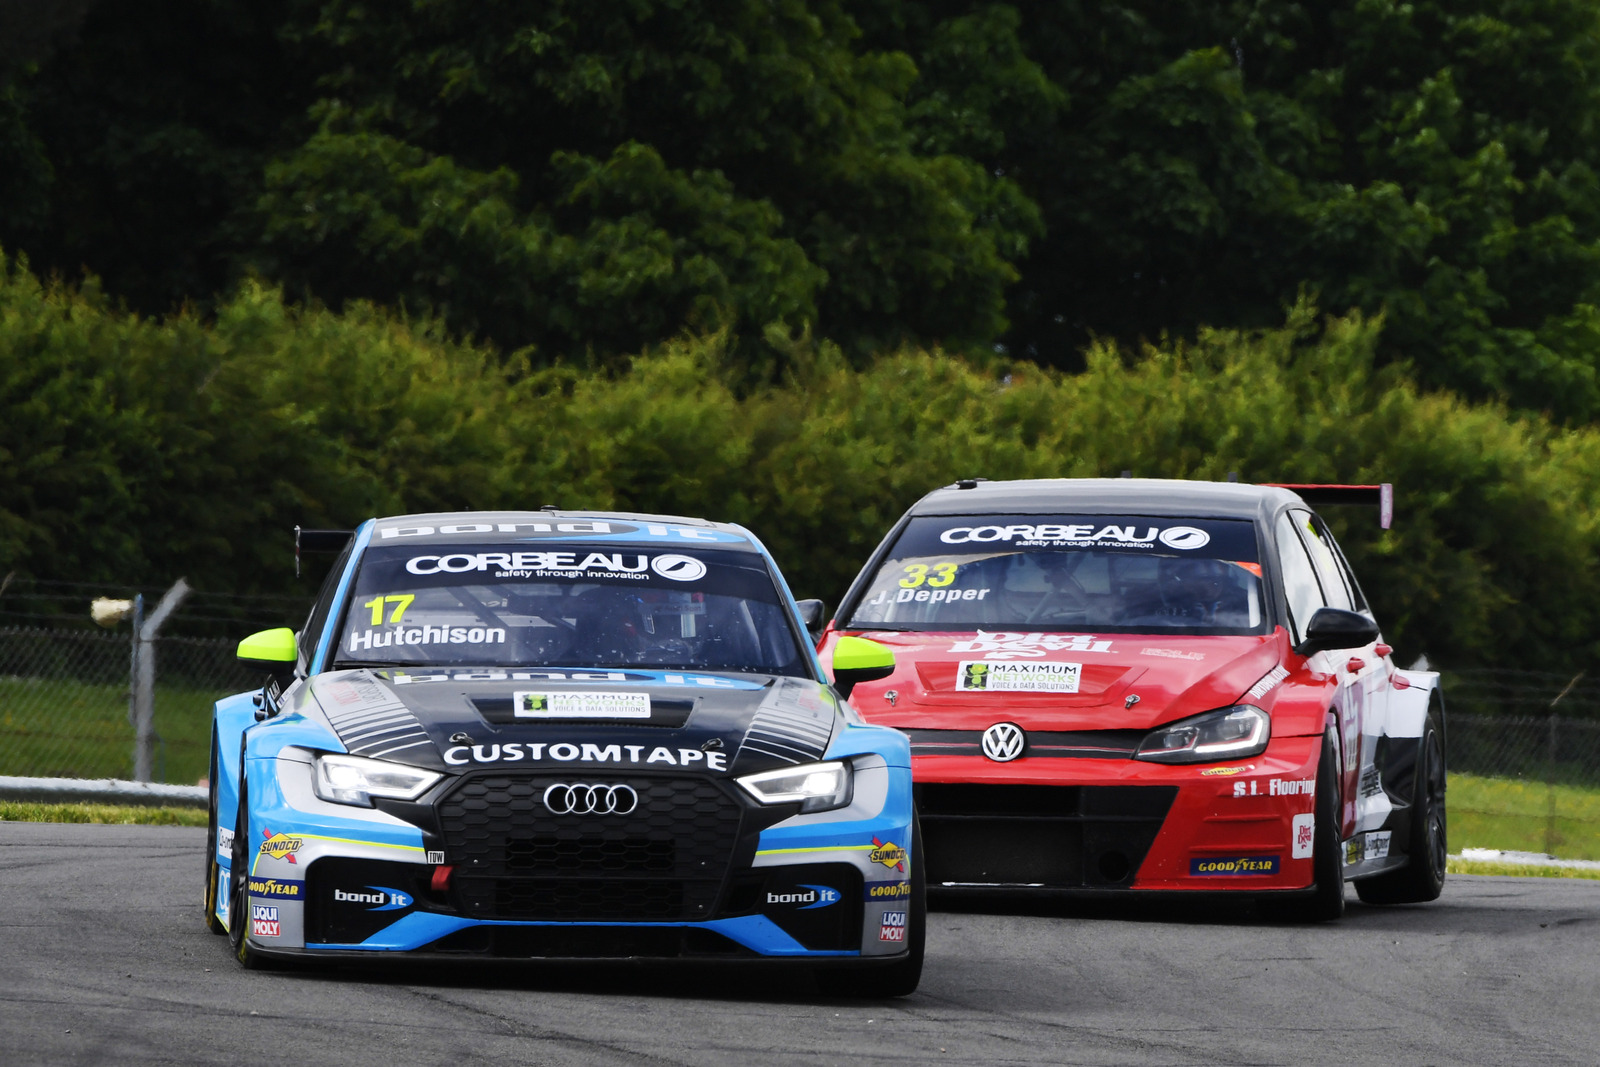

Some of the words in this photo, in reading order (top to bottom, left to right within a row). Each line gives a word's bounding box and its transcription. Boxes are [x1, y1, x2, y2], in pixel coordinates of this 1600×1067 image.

[380, 522, 611, 539] bond
[940, 525, 1157, 544] CORBEAU
[1053, 540, 1095, 548] through
[405, 552, 648, 575] CORBEAU
[495, 571, 532, 579] safety
[536, 570, 584, 579] through
[587, 570, 650, 579] innovation
[898, 562, 958, 588] 33
[364, 594, 415, 625] 17
[349, 625, 506, 651] Hutchison
[994, 664, 1077, 675] MAXIMUM
[393, 673, 627, 684] bond
[992, 673, 1075, 684] NETWORKS
[992, 682, 1011, 690] VOICE
[1019, 682, 1036, 690] DATA
[1037, 682, 1074, 691] SOLUTIONS
[443, 742, 727, 772] CUSTOMTAPE
[1269, 778, 1315, 797] Flooring
[261, 840, 299, 852] SUNOCO
[429, 851, 443, 864] TOW
[872, 849, 906, 861] SUNOCO
[1198, 858, 1272, 873] GOODYEAR
[335, 889, 384, 904] bond
[392, 893, 406, 905] it
[767, 890, 814, 903] bond
[821, 888, 835, 901] it
[253, 905, 278, 921] LIQUI
[882, 913, 905, 926] LIQUI
[254, 920, 279, 936] MOLY
[880, 927, 904, 940] MOLY
